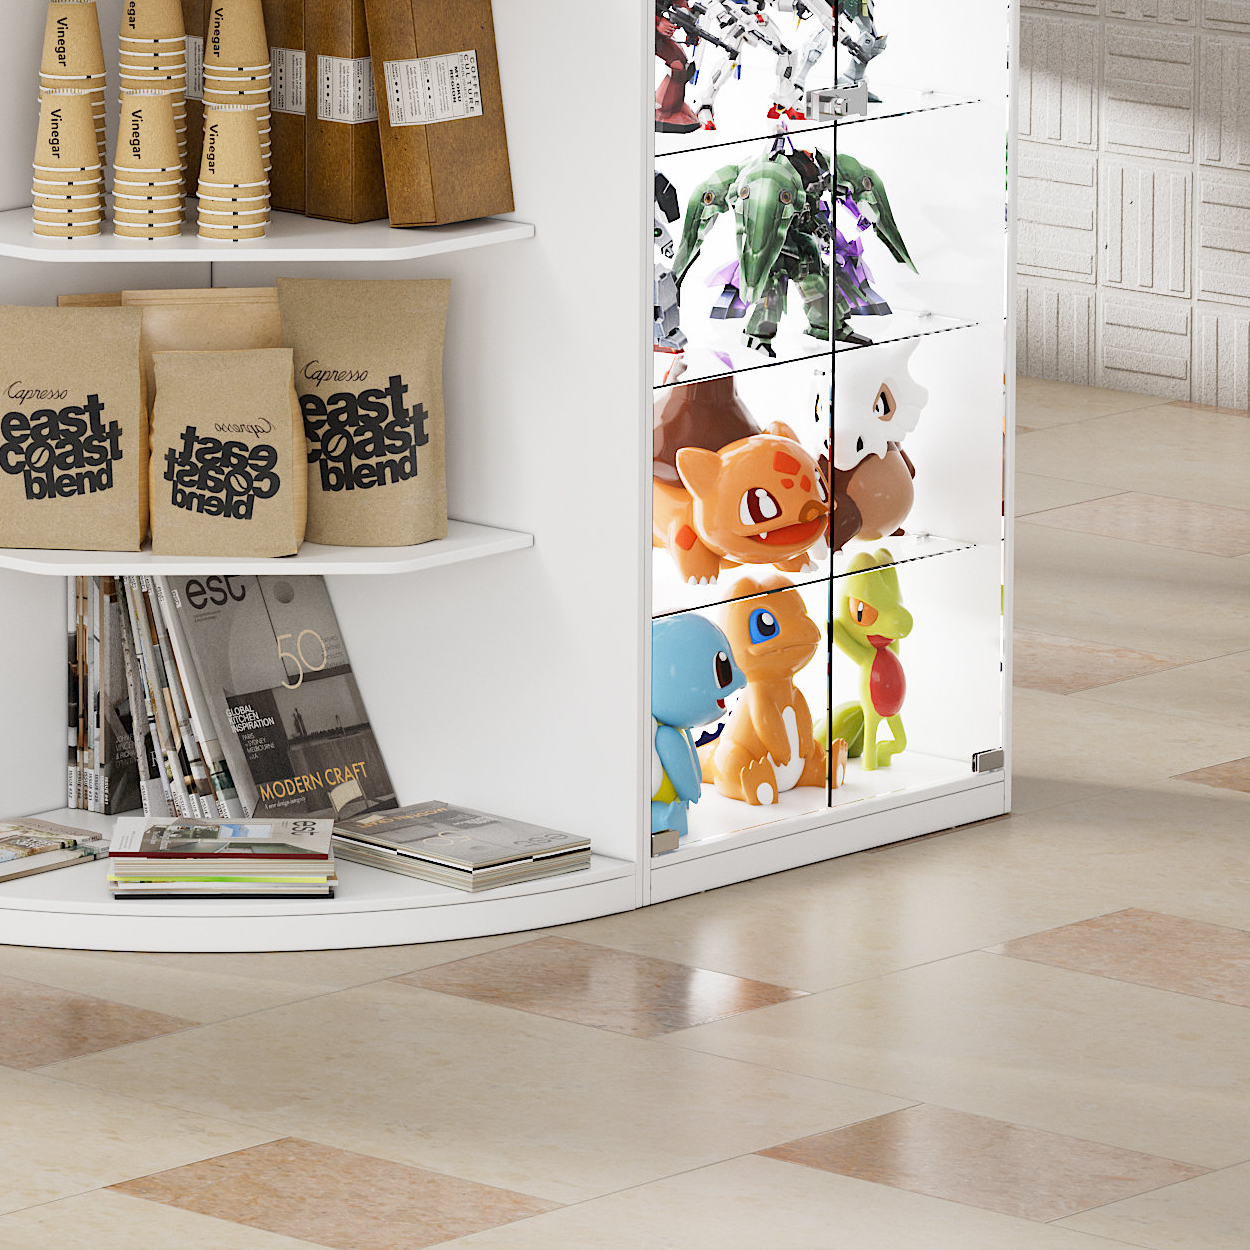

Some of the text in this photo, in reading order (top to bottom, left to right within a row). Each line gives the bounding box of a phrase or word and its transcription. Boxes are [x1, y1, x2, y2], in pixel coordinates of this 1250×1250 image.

[56, 16, 67, 67] Vinegar
[212, 7, 224, 58] Vinegar
[463, 54, 475, 112] CULTURE
[469, 56, 480, 106] COFFEE
[48, 108, 61, 159] Vinegar
[129, 109, 142, 160] Vinegar
[207, 124, 218, 175] Vinegar
[3, 380, 68, 405] Capresso
[300, 360, 369, 387] Capresso
[0, 394, 105, 445] east
[300, 375, 408, 430] east
[23, 458, 114, 500] blend
[320, 445, 418, 492] blend
[185, 575, 246, 610] est
[277, 629, 327, 690] 50
[226, 704, 254, 718] GLOBAL
[228, 712, 259, 726] KITCHEN
[231, 717, 275, 734] INSPIRATION
[259, 761, 367, 802] MODERN CRAFT
